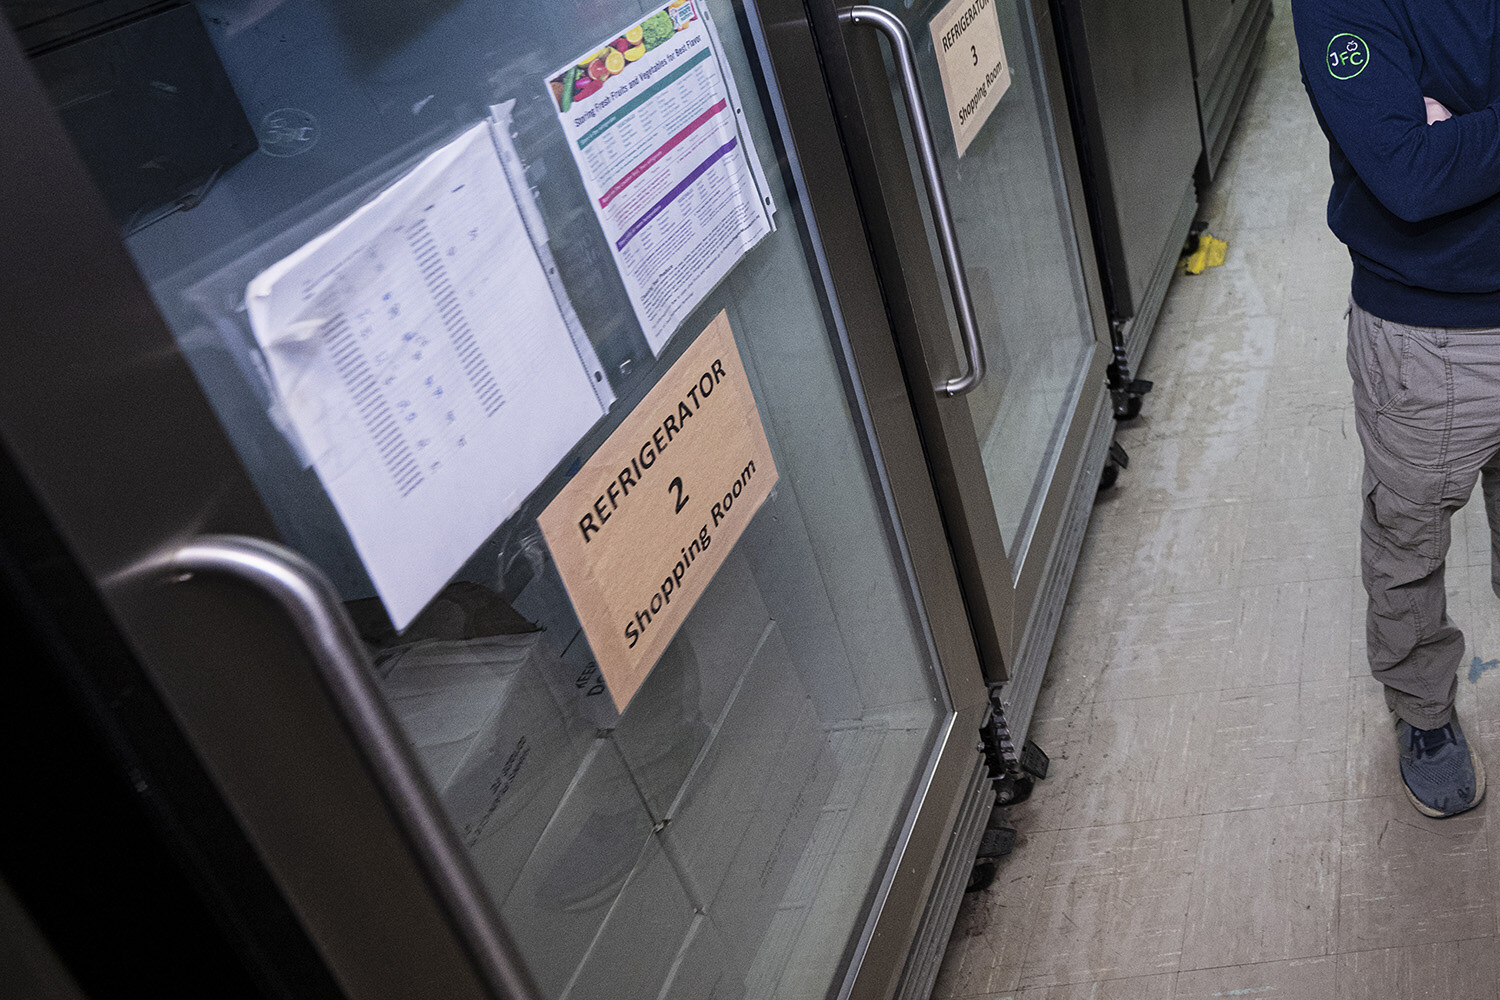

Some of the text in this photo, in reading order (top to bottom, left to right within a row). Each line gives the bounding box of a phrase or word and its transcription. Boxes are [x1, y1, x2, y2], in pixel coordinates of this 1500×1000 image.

[574, 103, 597, 128] Storing
[594, 95, 612, 115] Fresh
[610, 84, 629, 102] Fruits
[629, 76, 640, 90] and
[638, 57, 668, 86] Vegetables
[675, 44, 688, 58] Best
[686, 34, 702, 50] Flavor
[970, 45, 979, 67] 3
[1330, 49, 1364, 68] JFC
[958, 61, 1003, 126] Shopping Room
[577, 358, 727, 544] REFRIGERATOR
[667, 475, 691, 515] 2
[624, 460, 757, 650] Shopping Room
